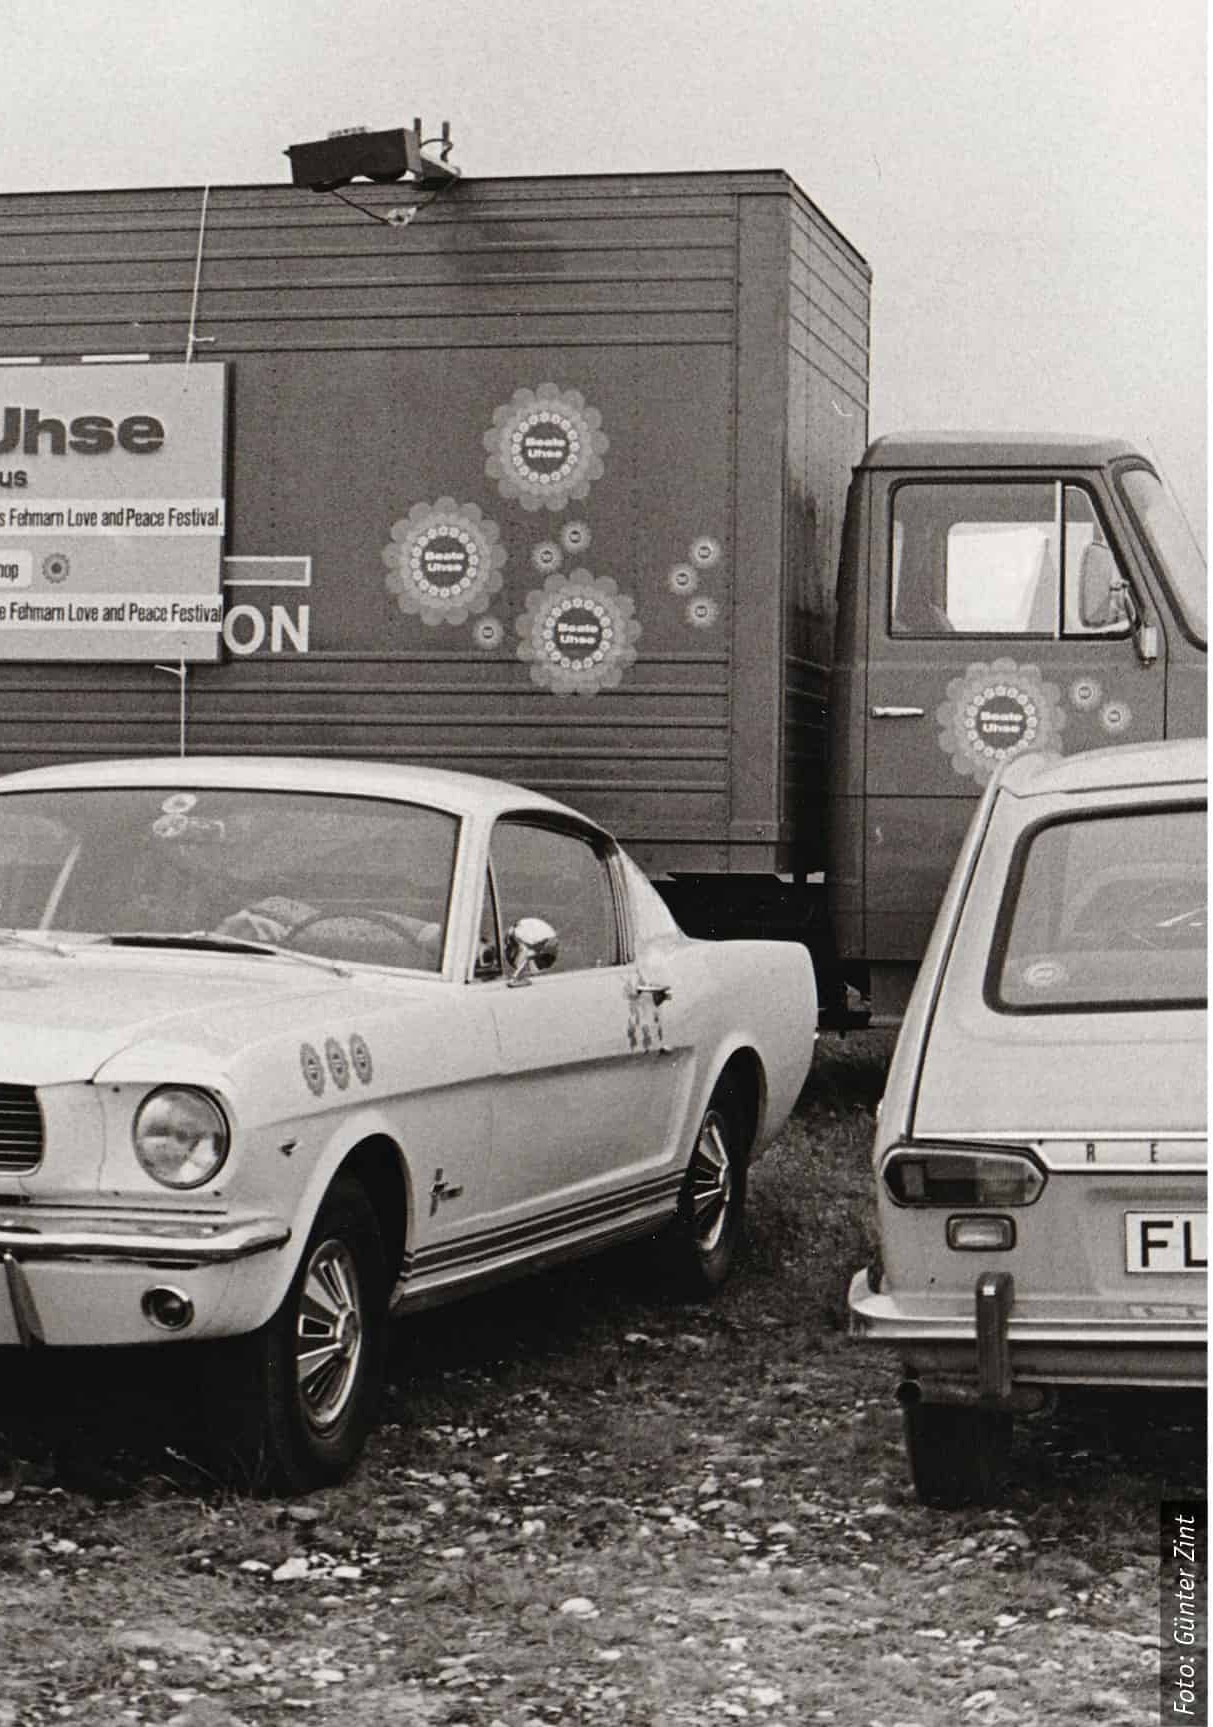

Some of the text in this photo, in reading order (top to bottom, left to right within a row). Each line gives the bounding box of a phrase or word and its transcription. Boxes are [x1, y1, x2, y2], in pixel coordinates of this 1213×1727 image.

[9, 507, 65, 528] Fehmarn
[67, 508, 98, 528] Love
[100, 507, 125, 528] and
[126, 507, 165, 528] Peace
[9, 601, 65, 622] Fehmarn
[67, 602, 99, 622] Love
[102, 602, 126, 622] and
[128, 602, 168, 622] Peace
[171, 602, 222, 623] Festival
